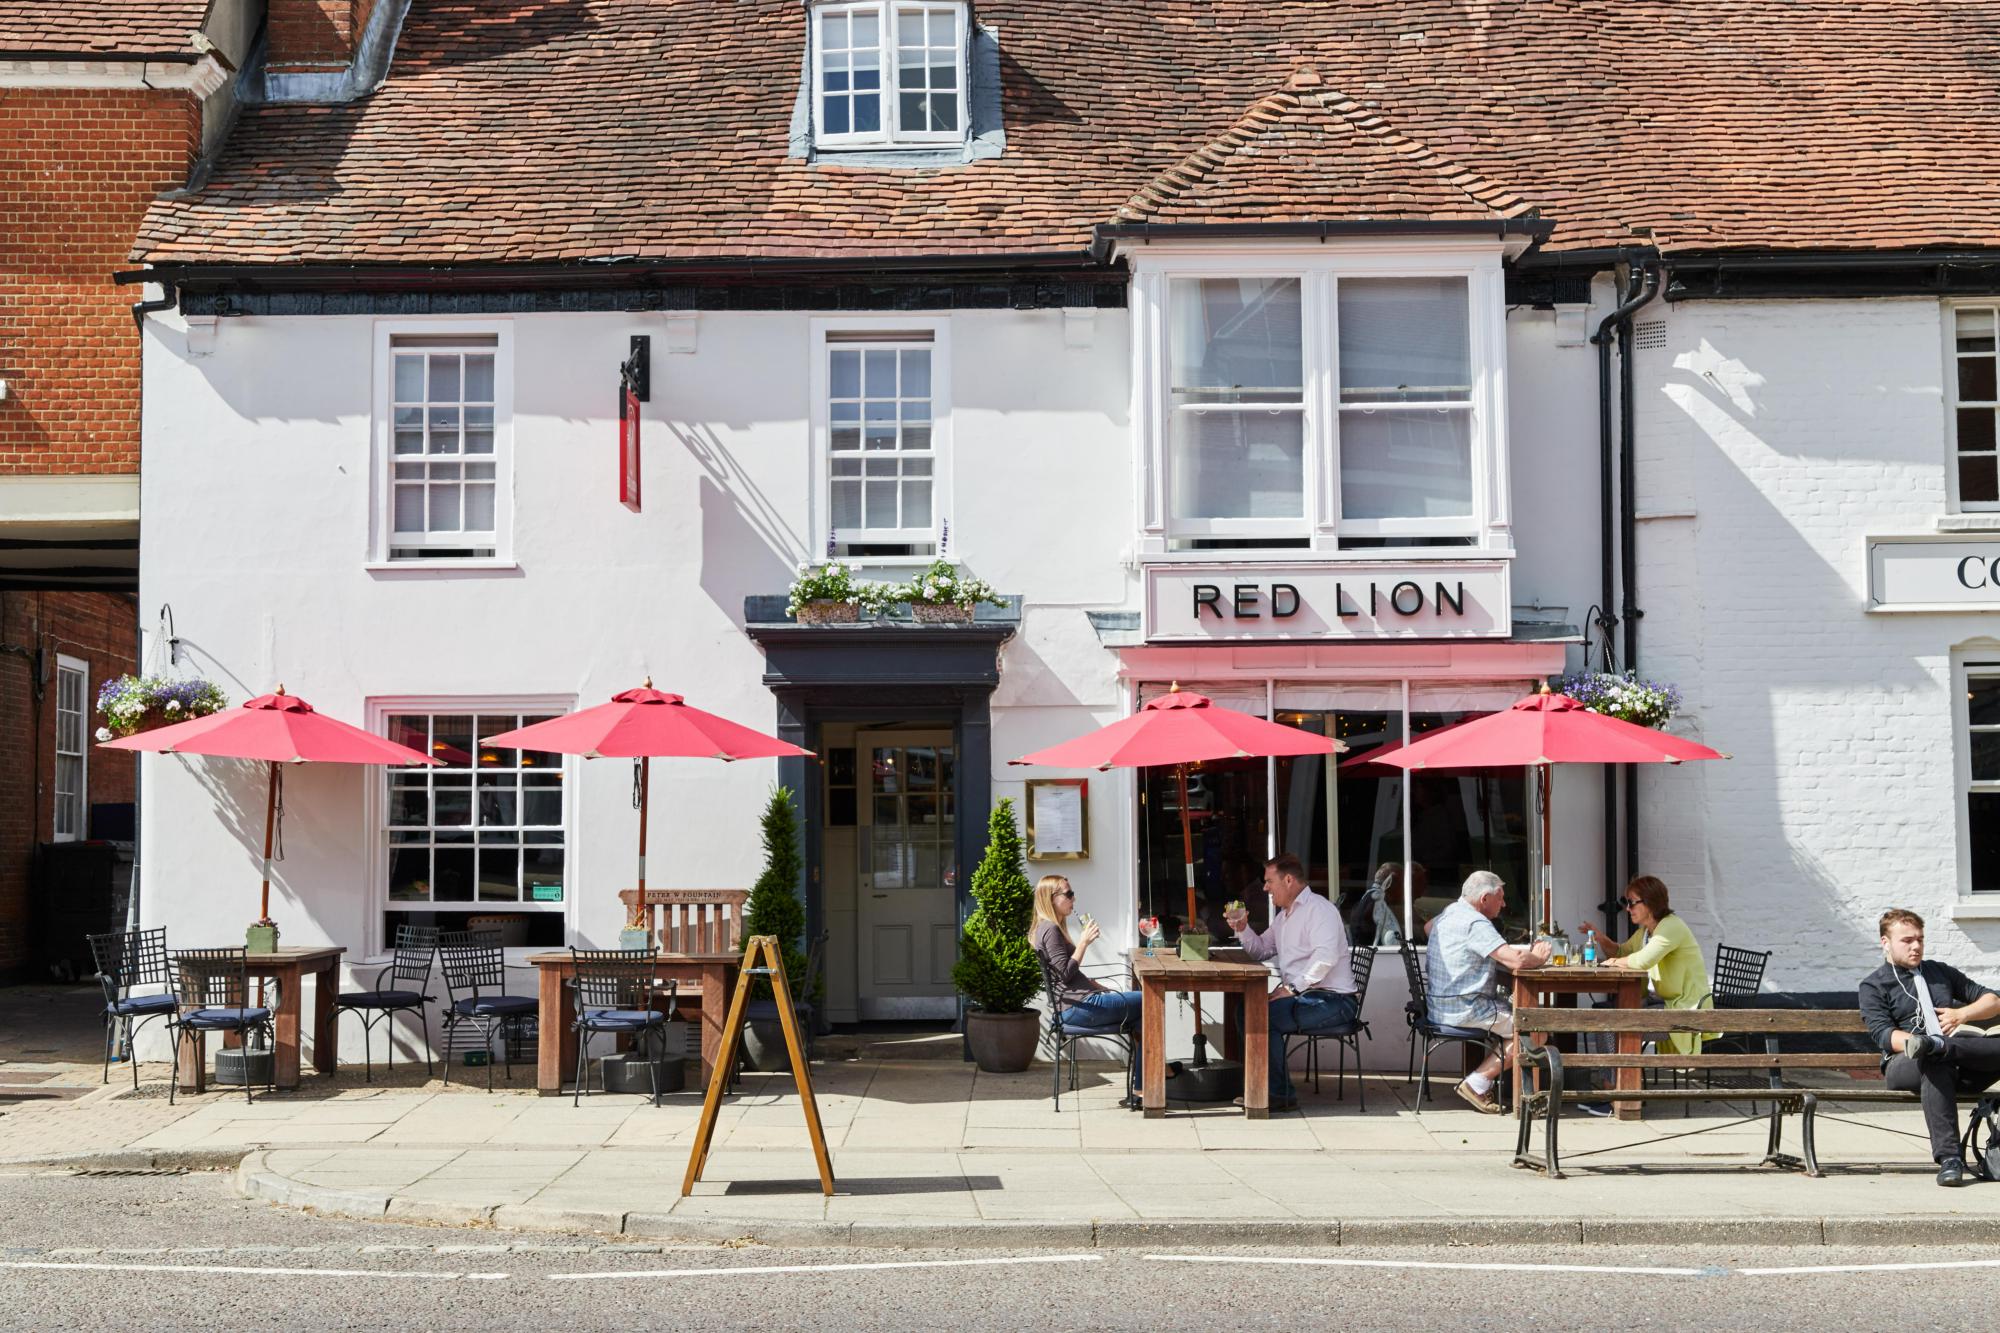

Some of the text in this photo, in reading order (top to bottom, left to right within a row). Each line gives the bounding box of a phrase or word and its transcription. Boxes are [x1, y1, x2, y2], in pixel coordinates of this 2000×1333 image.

[1957, 555, 2000, 589] C
[1193, 581, 1464, 619] RED LION
